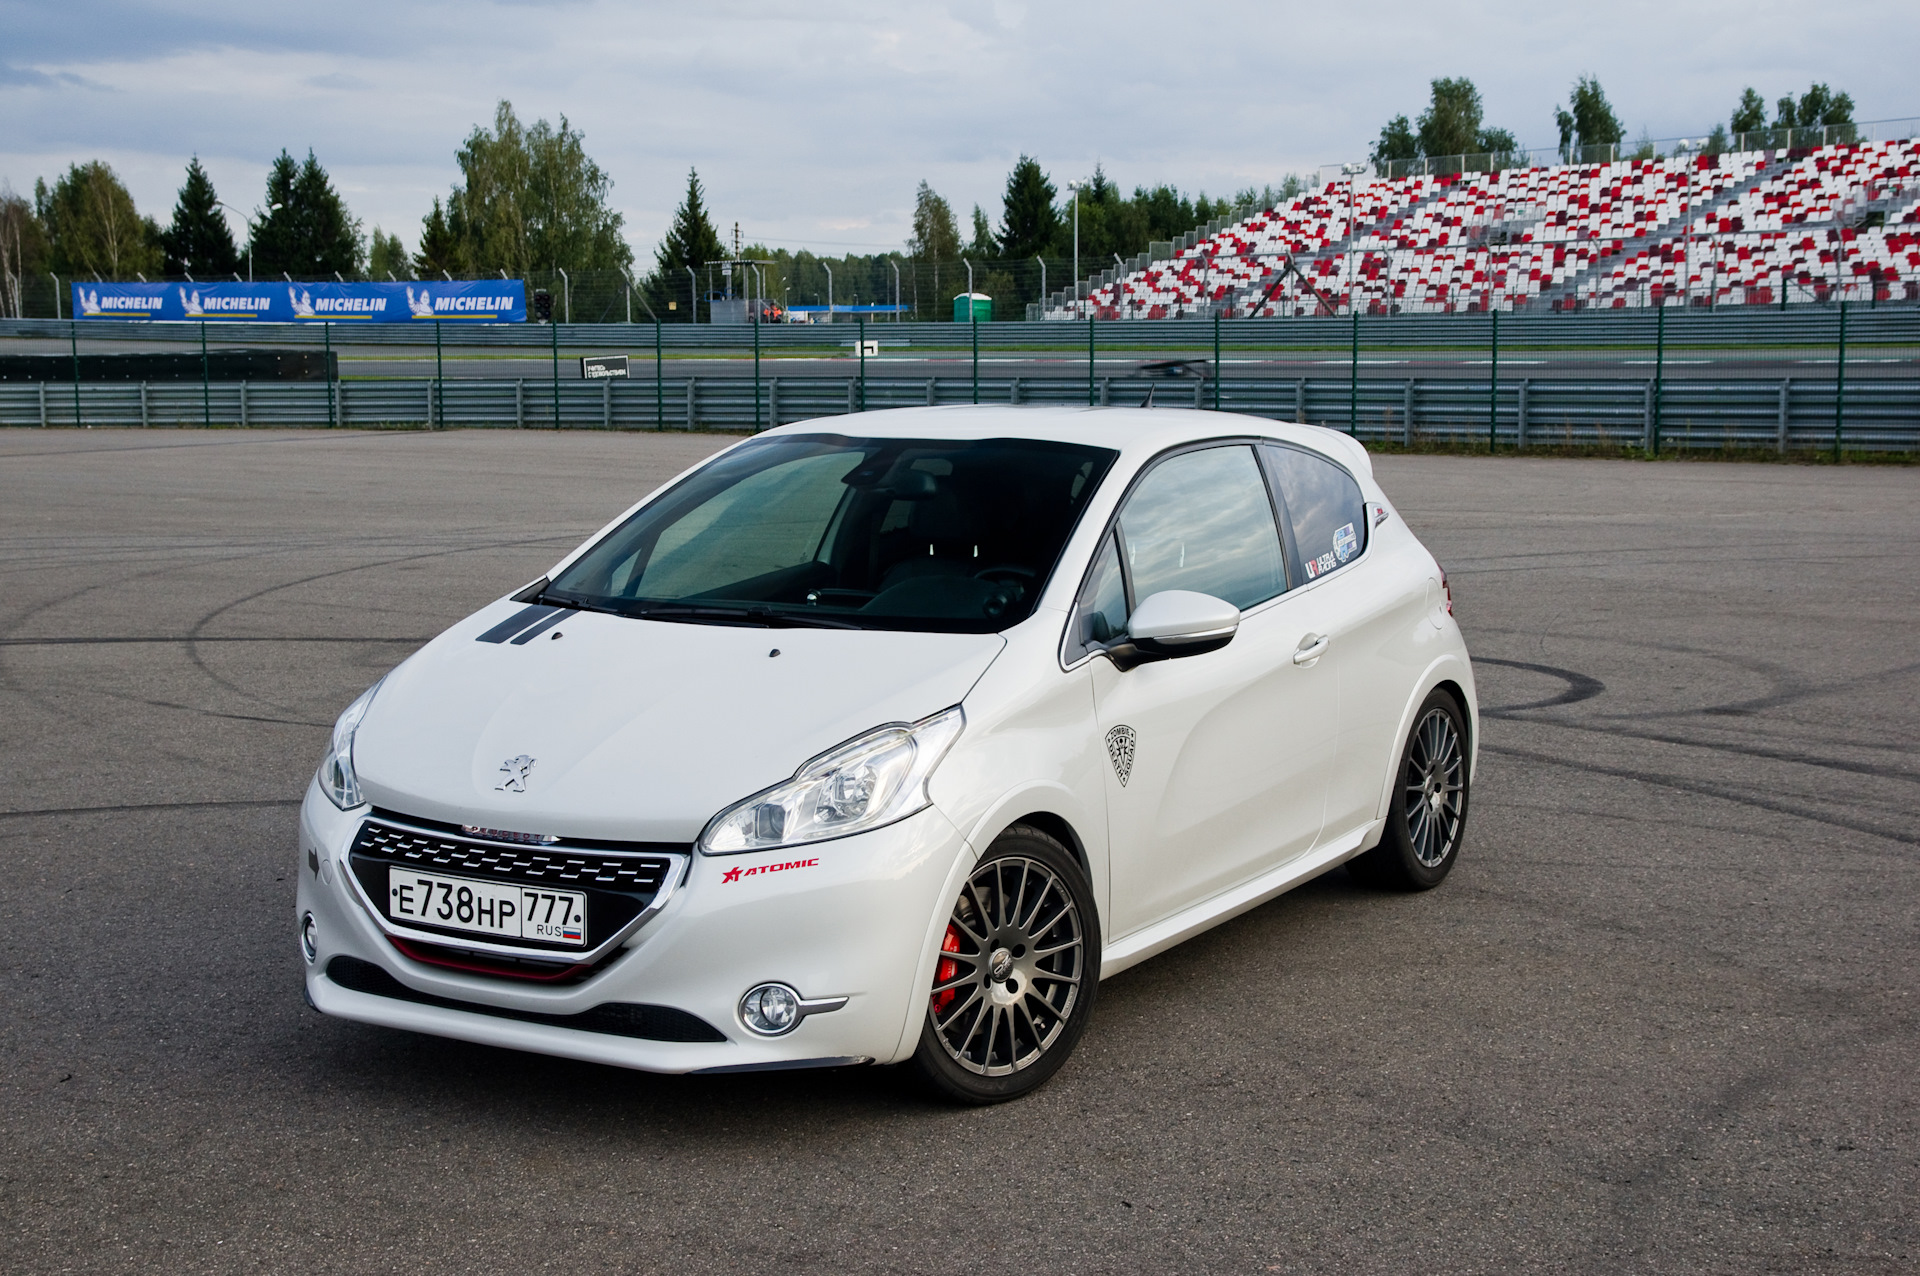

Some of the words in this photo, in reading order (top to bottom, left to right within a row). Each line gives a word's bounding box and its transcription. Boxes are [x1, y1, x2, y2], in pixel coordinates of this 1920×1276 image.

[101, 296, 163, 310] MICHELIN
[203, 297, 270, 311] MICHELIN
[315, 297, 387, 312] MICHELIN
[434, 296, 514, 311] MICHELIN
[1110, 727, 1130, 740] ZOMBIE
[1109, 743, 1124, 778] DEATH
[1124, 739, 1135, 777] SQUAD
[743, 857, 820, 877] ATOMIC
[399, 878, 516, 929] E738HP
[524, 891, 574, 926] 777
[536, 924, 562, 938] RUS
